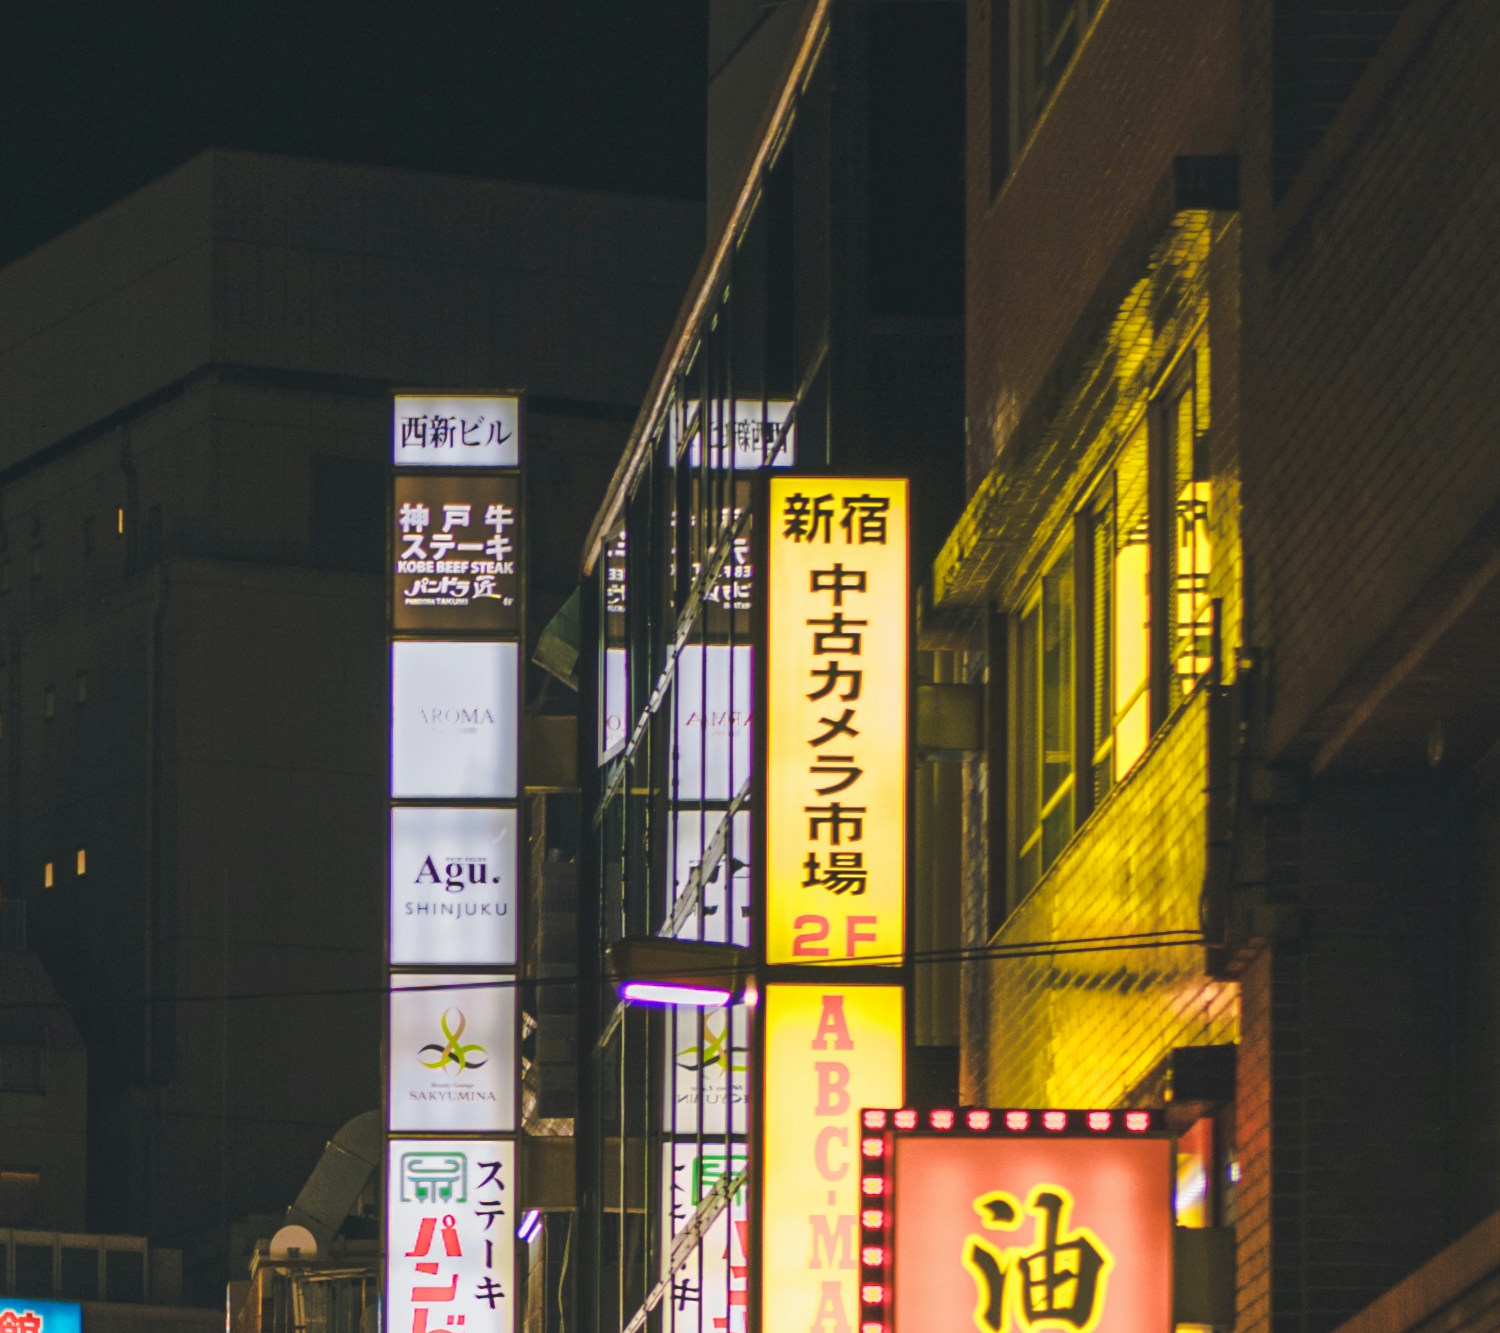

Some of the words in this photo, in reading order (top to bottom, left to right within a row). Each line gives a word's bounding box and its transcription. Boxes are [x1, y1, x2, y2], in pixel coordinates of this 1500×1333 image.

[400, 415, 514, 450] 西新ビル
[398, 502, 515, 534] 神戸牛
[782, 492, 892, 547] 新宿
[400, 533, 513, 561] ステーキ
[398, 560, 435, 575] KOBE
[435, 560, 470, 575] BEEF
[470, 560, 515, 575] STEAK
[404, 575, 471, 598] パンドラ
[472, 575, 502, 599] 匠
[801, 563, 869, 897] 中古カメラ市場
[413, 854, 501, 893] Agu.
[405, 901, 509, 920] SHINJUKU
[791, 914, 878, 958] 2F
[408, 1091, 497, 1102] SAKYUMINA
[474, 1160, 506, 1310] ステーキ
